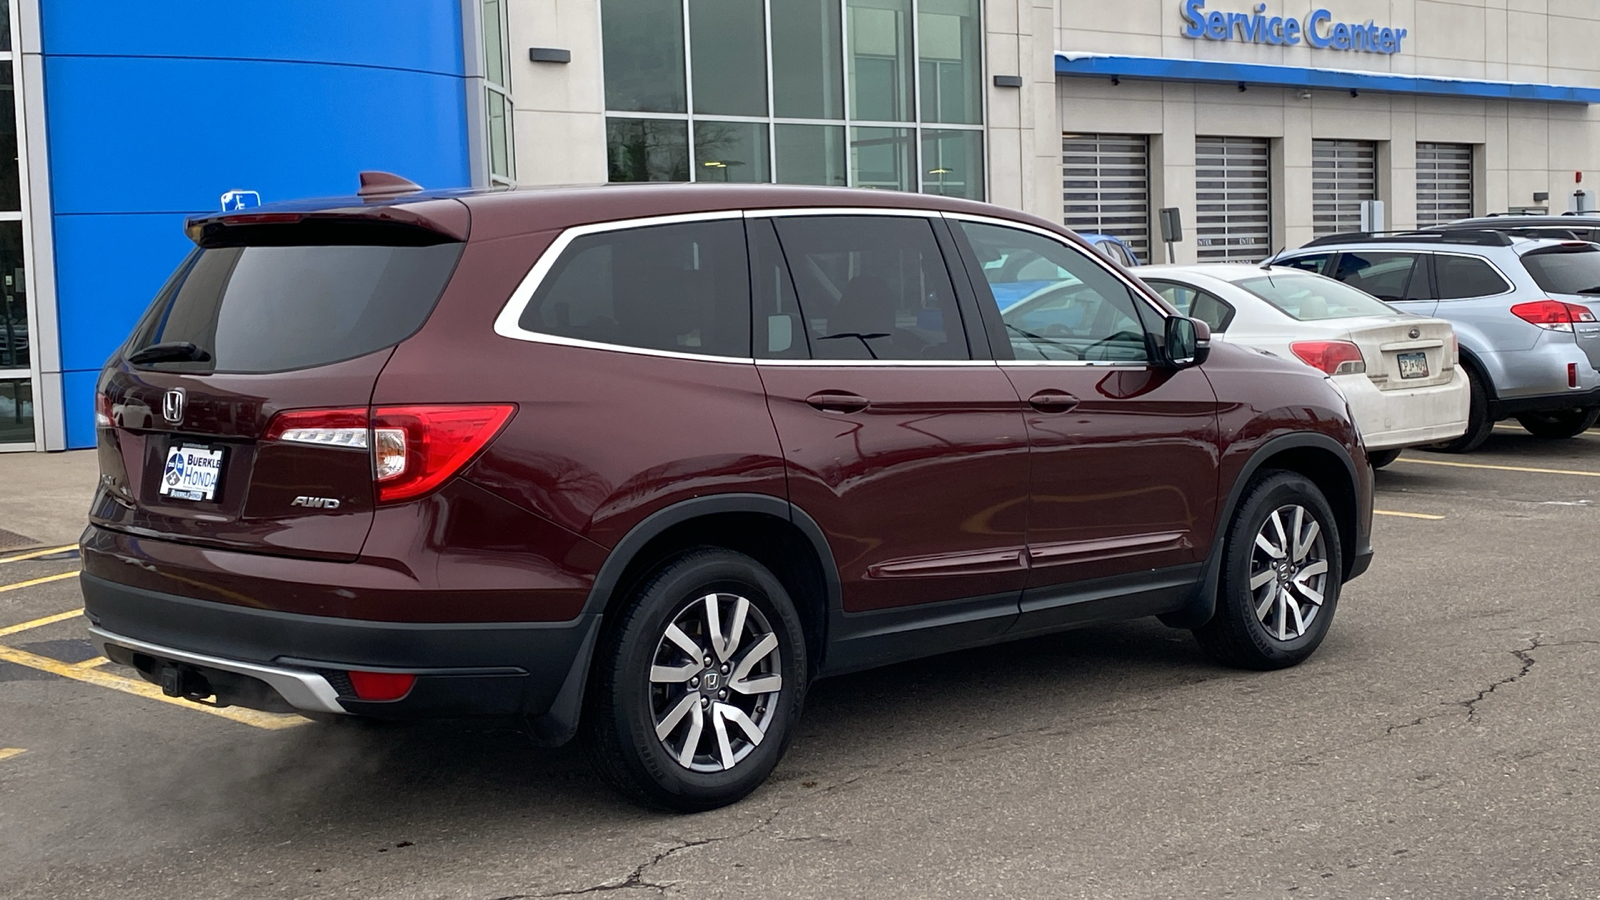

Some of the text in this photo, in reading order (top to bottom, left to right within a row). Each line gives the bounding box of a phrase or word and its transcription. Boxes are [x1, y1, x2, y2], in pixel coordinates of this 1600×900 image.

[1181, 0, 1407, 54] Service Center
[187, 454, 221, 468] BUERKLE
[183, 467, 217, 487] HONDA
[290, 496, 340, 509] AWD
